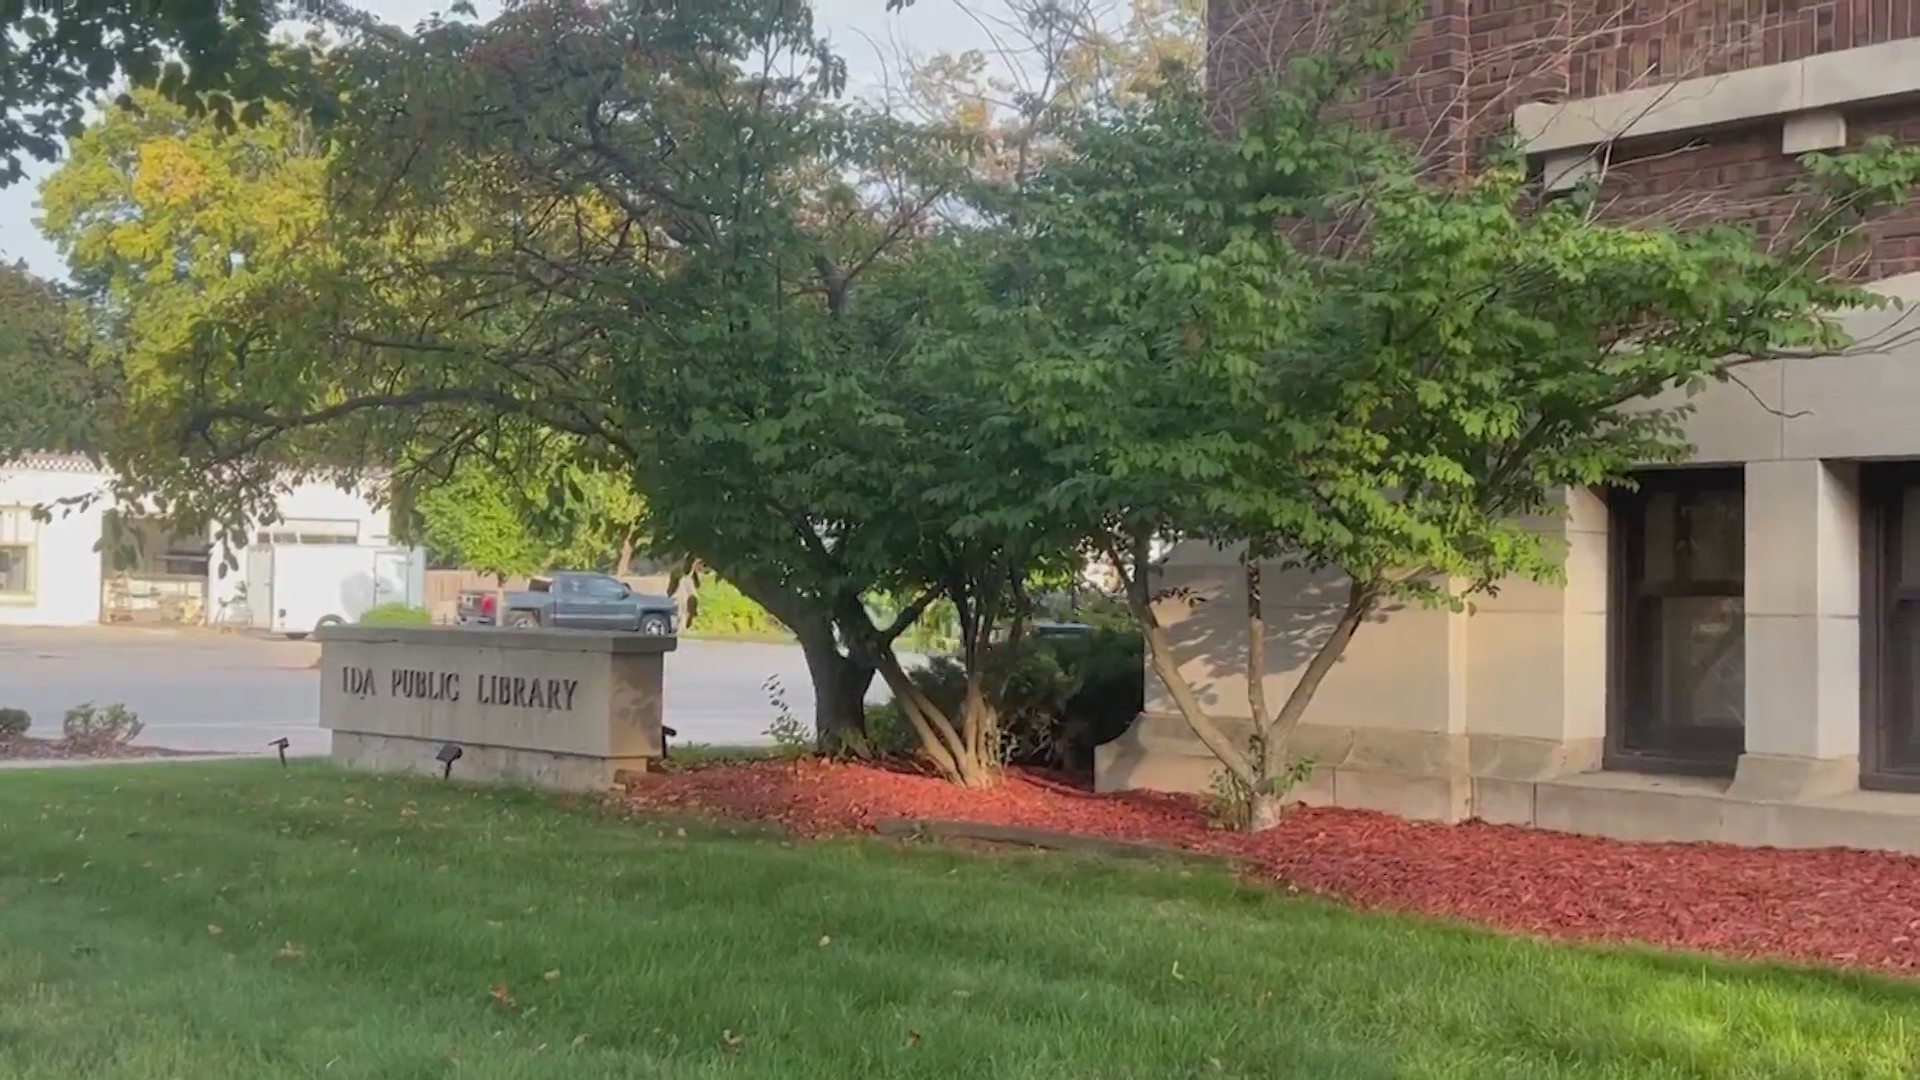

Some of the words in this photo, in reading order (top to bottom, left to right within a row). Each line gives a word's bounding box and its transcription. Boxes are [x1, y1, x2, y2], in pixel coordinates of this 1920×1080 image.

[342, 666, 377, 696] IDA
[391, 669, 460, 702] PUBLIC
[477, 674, 578, 711] LIBRARY
